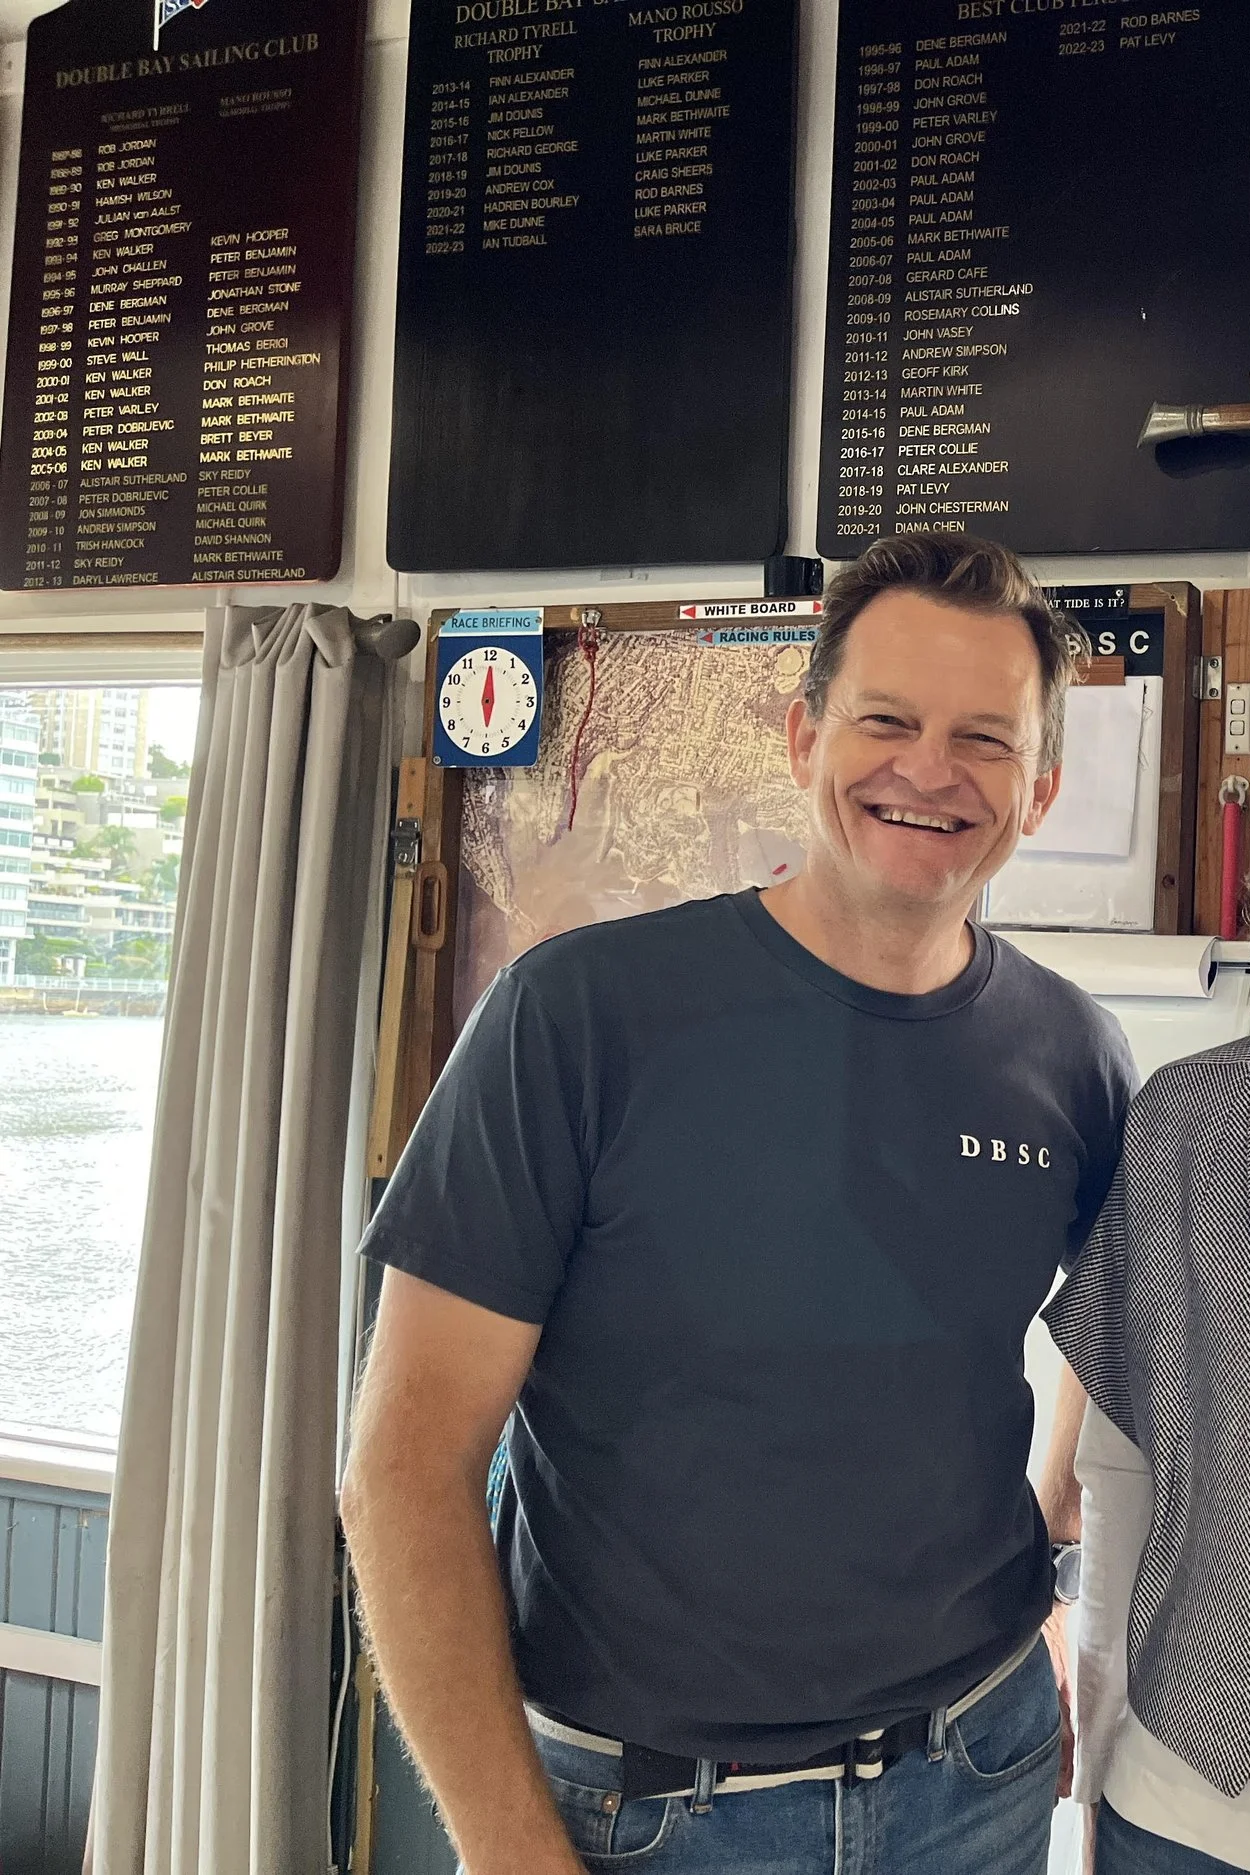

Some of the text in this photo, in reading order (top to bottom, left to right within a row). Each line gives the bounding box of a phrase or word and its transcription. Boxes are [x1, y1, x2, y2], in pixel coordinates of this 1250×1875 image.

[456, 0, 539, 24] DOUBLE
[629, 0, 743, 26] MANO ROUSSO
[958, 0, 1004, 20] BEST
[1060, 9, 1200, 35] 2021-22 ROD BARNES
[455, 21, 577, 49] RICHARD TYRELL
[653, 22, 716, 43] TROPHY
[916, 32, 1007, 51] DENE BERGMAN
[1059, 32, 1175, 55] 2022-23 PAT LEVY
[56, 33, 318, 88] DOUBLE BAY SAILING CLUB
[487, 44, 542, 63] TROPHY
[432, 68, 574, 94] 2013-14 FINN ALEXANDER
[637, 105, 730, 125] MARK BETHWAITE
[855, 131, 985, 153] 2000-01 JOHN GROVE
[429, 141, 578, 165] 2017-18 RICHARD GEORGE
[854, 151, 979, 172] 2001-02 DON ROACH
[485, 179, 554, 195] ANDREW COX
[635, 183, 703, 199] ROD BARNES
[211, 228, 288, 246] KEVIN HOOPER
[850, 226, 1009, 248] 2005-06 MARK BETHWAITE
[849, 267, 987, 286] 2007-08 GERARD CAFE
[848, 283, 1033, 305] 2008-09 ALISTAIR SUTHERLAND
[847, 303, 1019, 325] 2009-10 ROSEMARY COLLINS
[846, 326, 973, 344] 2010-11 JOHN VASEY
[87, 354, 116, 365] STEVE
[122, 351, 148, 361] WALL
[845, 344, 1007, 363] 2011-12 ANDREW SIMPSON
[204, 353, 320, 372] PHILIP HETHERINGTON
[86, 372, 105, 383] KEN
[112, 368, 152, 380] WALKER
[844, 366, 968, 382] 2012-13 GEOFF KIRK
[204, 376, 271, 390] DON ROACH
[85, 390, 105, 400] KEN
[110, 386, 150, 398] WALKER
[843, 384, 982, 401] 2013-14 MARTIN WHITE
[203, 393, 294, 408] MARK BETHWAITE
[84, 407, 114, 418] PETER
[119, 403, 159, 415] VARLEY
[843, 404, 964, 420] 2014-15 PAUL ADAM
[202, 411, 294, 427] MARK BETHWAITE
[83, 425, 113, 436] PETER
[118, 420, 174, 433] DOBRIJEVIC
[842, 423, 990, 439] 2015-16 DENE BERGMAN
[201, 430, 272, 444] BRETT BEYER
[82, 442, 102, 453] KEN
[108, 439, 148, 451] WALKER
[841, 443, 978, 458] 2016-17 PETER COLLIE
[200, 447, 292, 462] MARK BETHWAITE
[81, 460, 101, 470] KEN
[108, 456, 147, 468] WALKER
[840, 461, 1008, 477] 2017-18 CLARE ALEXANDER
[839, 483, 949, 497] 2018-19 PAT LEVY
[838, 501, 1008, 516] 2019-20 JOHN CHESTERMAN
[837, 521, 964, 535] 2020-21 DIANA CHEN
[194, 550, 283, 562] MARK BETHWAITE
[192, 568, 305, 580] ALISTAIR SUTHERLAND
[704, 602, 796, 616] WHITE BOARD
[1064, 599, 1090, 608] TIDE
[1094, 598, 1104, 608] IS
[451, 617, 531, 628] RACE BRIEFING
[719, 631, 815, 643] RACING RULES
[484, 650, 497, 661] 12
[510, 658, 515, 668] 1
[462, 658, 473, 669] 11
[448, 674, 460, 685] 10
[522, 673, 529, 684] 2
[443, 697, 450, 708] 9
[526, 696, 534, 707] 3
[448, 719, 456, 730] 8
[518, 719, 526, 730] 4
[462, 737, 470, 748] 7
[481, 743, 489, 753] 6
[502, 737, 510, 748] 5
